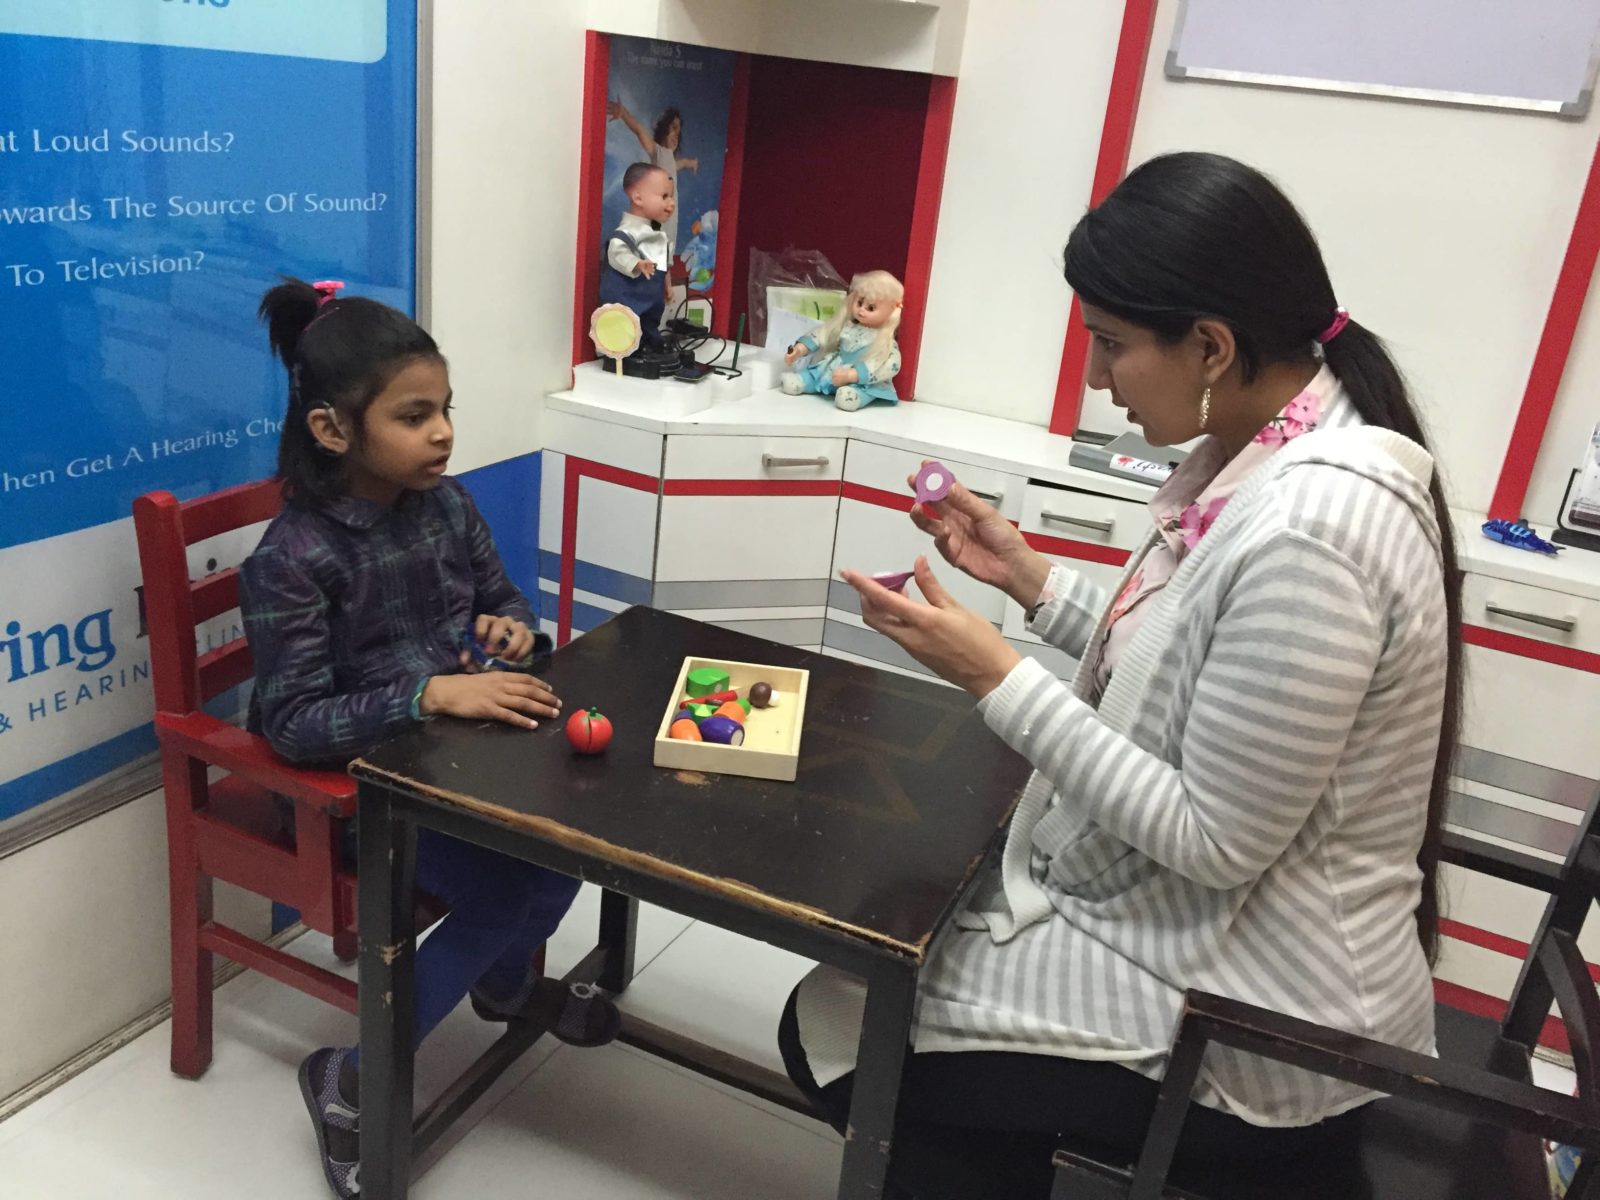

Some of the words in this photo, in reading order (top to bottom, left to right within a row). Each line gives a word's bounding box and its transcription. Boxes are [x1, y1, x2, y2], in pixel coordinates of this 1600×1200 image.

[33, 128, 110, 152] Loud
[121, 129, 235, 153] Sounds?
[0, 197, 92, 225] wards
[104, 196, 157, 219] The
[167, 195, 256, 217] Source
[265, 192, 298, 213] Of
[304, 192, 388, 213] Sound?
[6, 264, 45, 287] To
[56, 250, 205, 282] Television?
[66, 454, 114, 478] Get
[122, 447, 144, 466] A
[151, 427, 240, 460] Hearing
